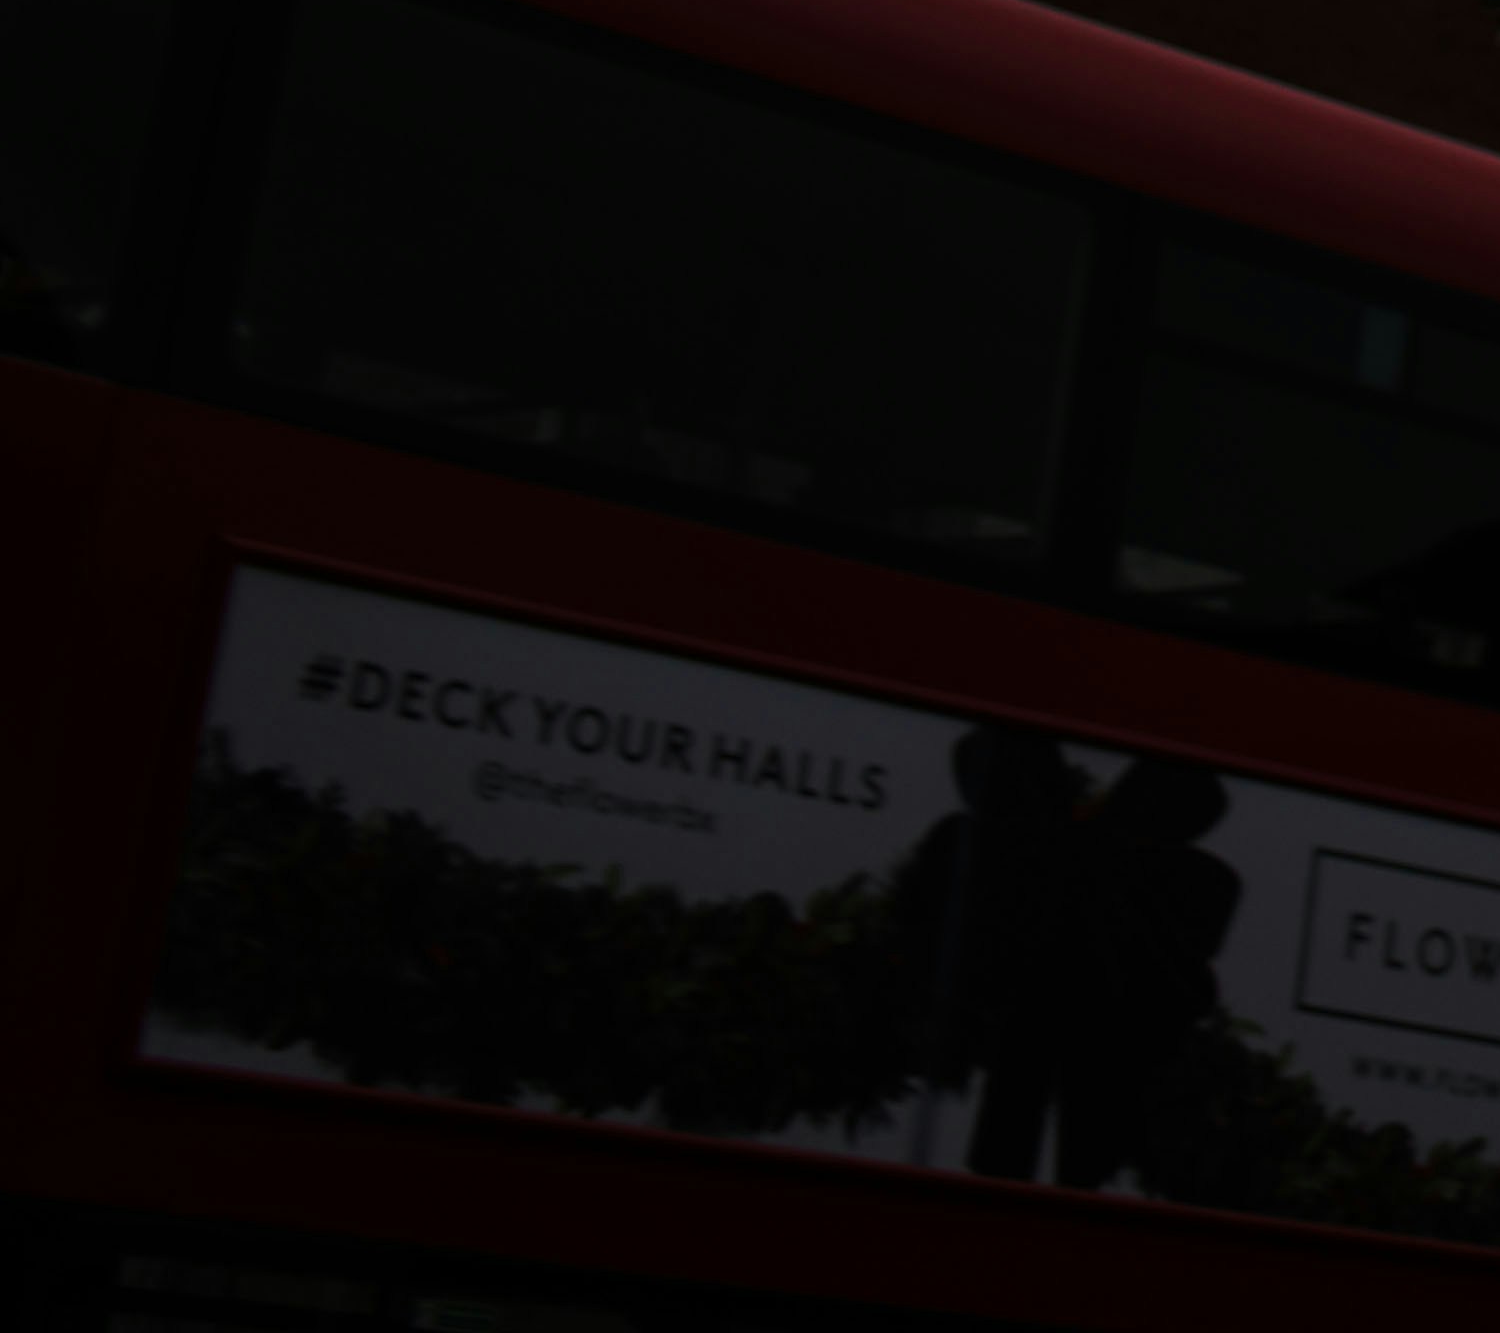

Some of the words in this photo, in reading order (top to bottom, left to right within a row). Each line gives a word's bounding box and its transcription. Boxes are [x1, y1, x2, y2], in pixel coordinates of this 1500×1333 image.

[299, 653, 513, 739] #DECK
[530, 696, 696, 774] YOUR
[708, 734, 891, 811] HALLS
